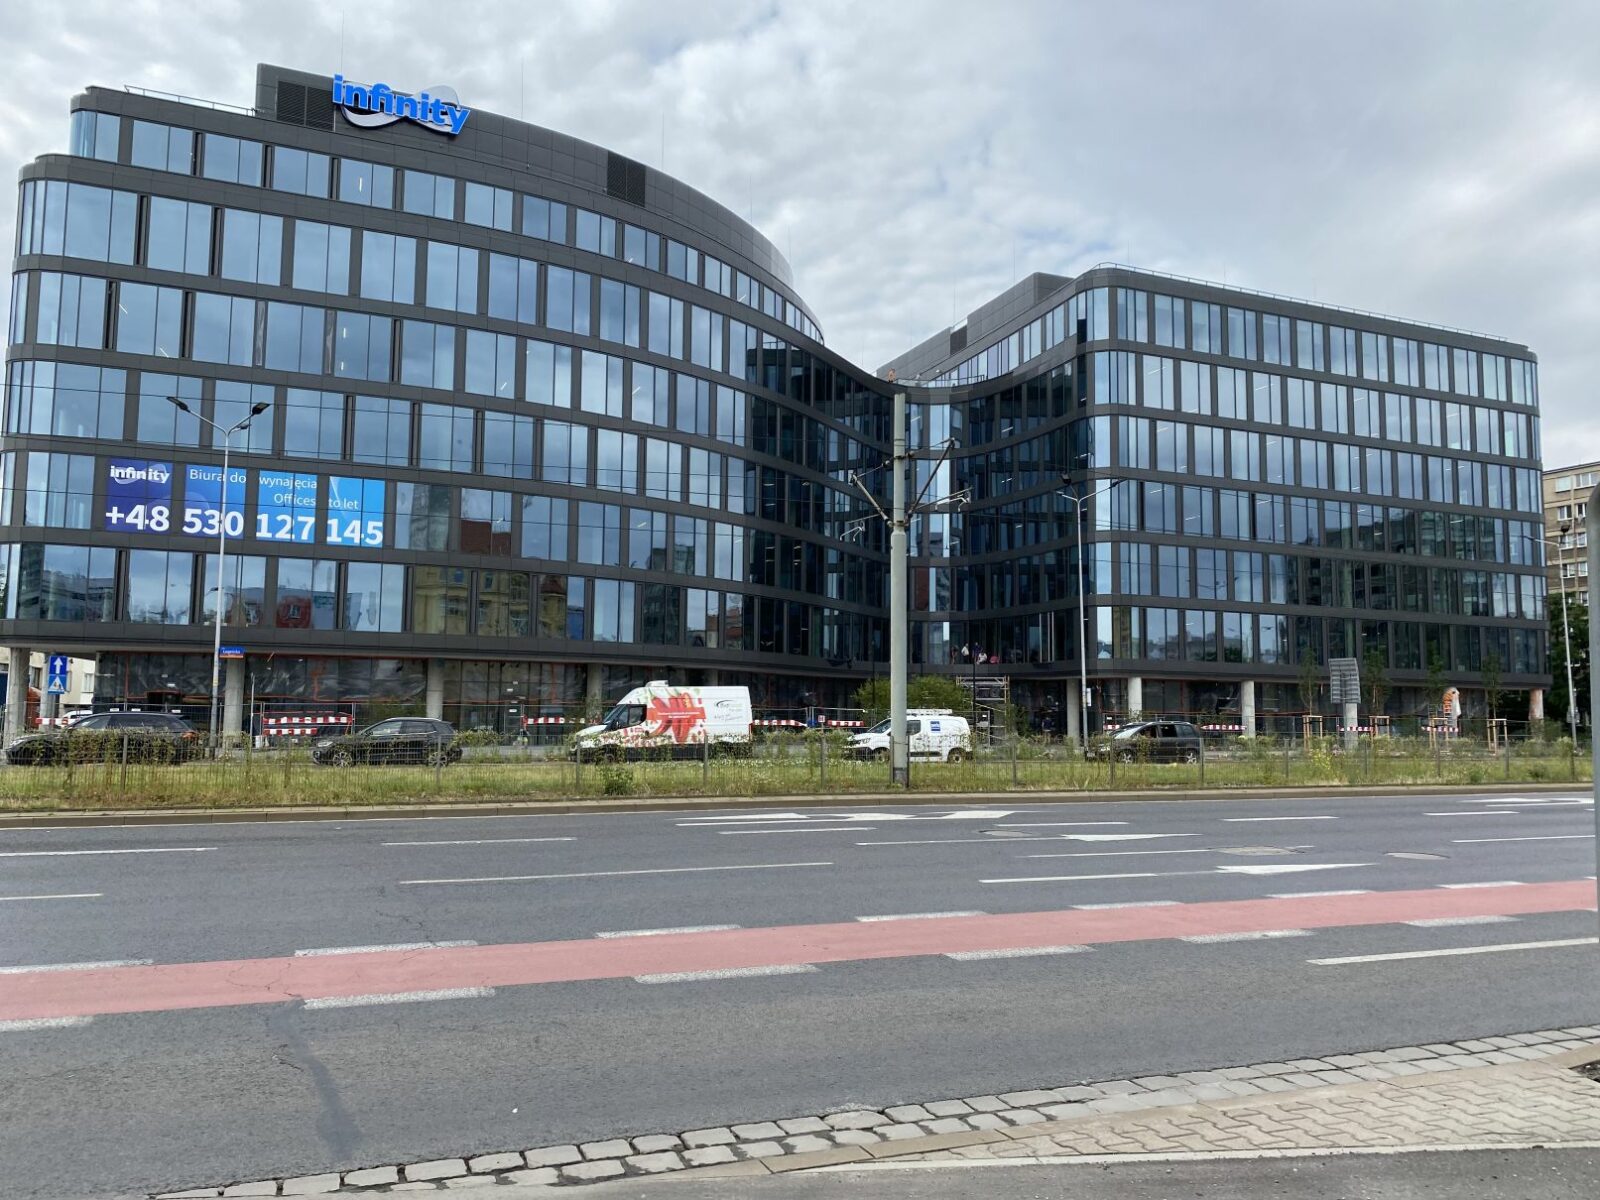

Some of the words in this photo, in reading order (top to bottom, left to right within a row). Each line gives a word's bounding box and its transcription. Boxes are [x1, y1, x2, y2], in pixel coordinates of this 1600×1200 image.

[333, 74, 471, 135] infinity
[110, 465, 170, 484] infinity
[189, 468, 226, 482] Biura
[230, 472, 247, 483] do
[259, 476, 318, 490] wynajęcia
[273, 493, 316, 506] Offices
[328, 498, 341, 508] to
[343, 498, 359, 510] let
[105, 504, 170, 532] +48
[182, 508, 244, 536] 530
[256, 513, 316, 540] 127
[326, 518, 384, 545] 145
